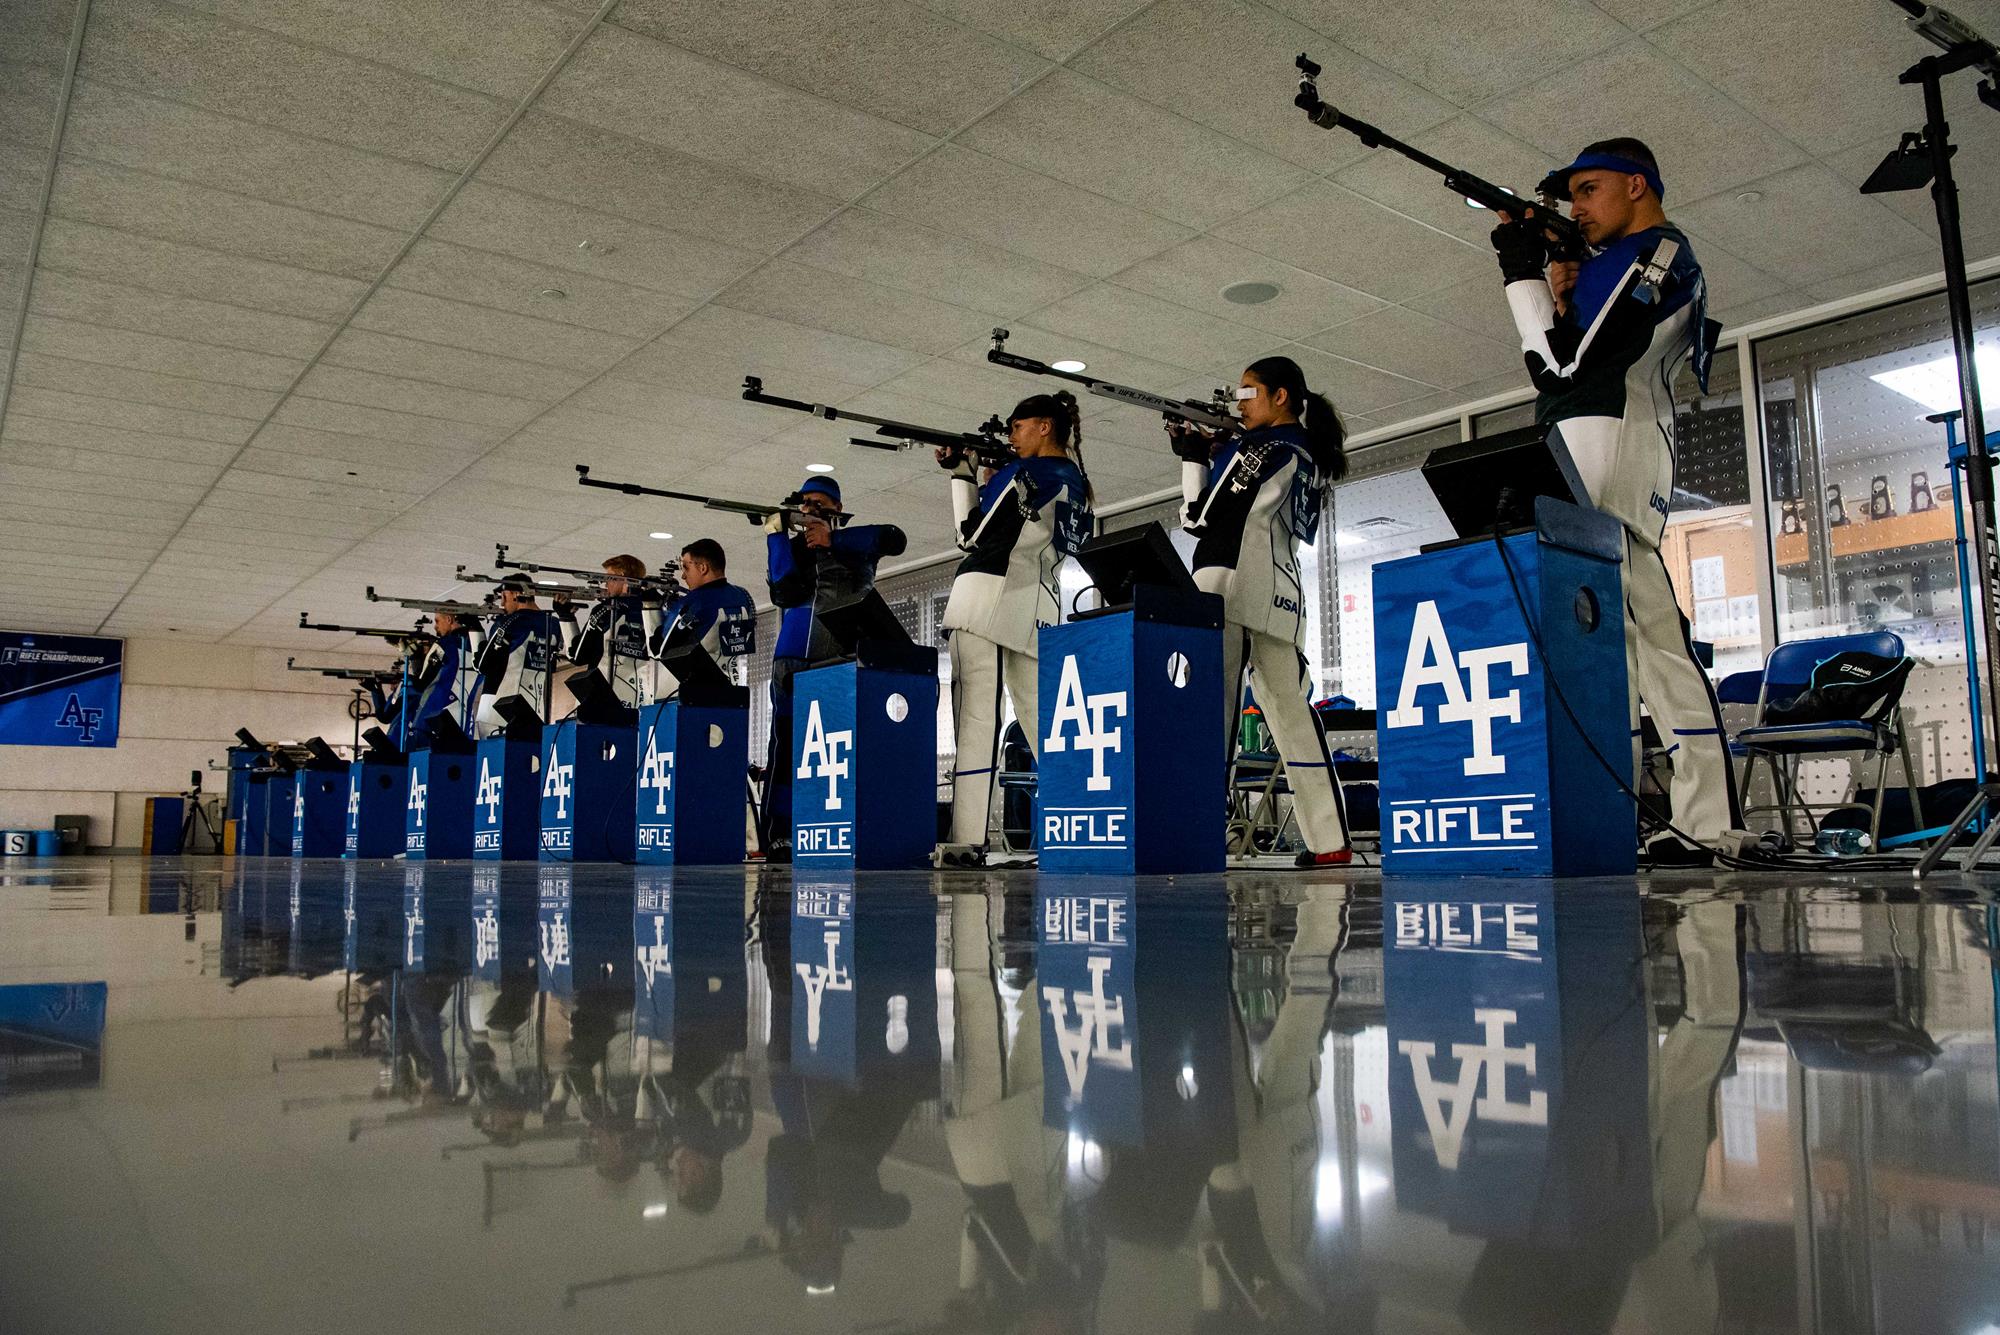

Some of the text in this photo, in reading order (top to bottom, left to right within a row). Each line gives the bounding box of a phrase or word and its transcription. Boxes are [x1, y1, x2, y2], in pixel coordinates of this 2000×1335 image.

[1650, 491, 1668, 517] USA
[1273, 595, 1298, 614] USA
[19, 652, 40, 661] RIFLE
[41, 653, 105, 664] CHAMPIONSHIPS
[1387, 599, 1530, 777] AF
[55, 692, 104, 742] AF
[1043, 654, 1127, 792] AF
[797, 699, 853, 811] AF
[542, 743, 574, 819] AF
[639, 726, 674, 815] AF
[407, 767, 427, 827] AF
[475, 757, 502, 824] AF
[541, 828, 571, 847] RIFLE
[638, 829, 671, 846] RIFLE
[1045, 814, 1126, 842] RIFLE
[1392, 803, 1535, 844] RIFLE
[11, 835, 25, 853] S
[407, 835, 425, 848] RIFLE
[474, 833, 500, 847] RIFLE
[797, 827, 851, 850] RIFLE
